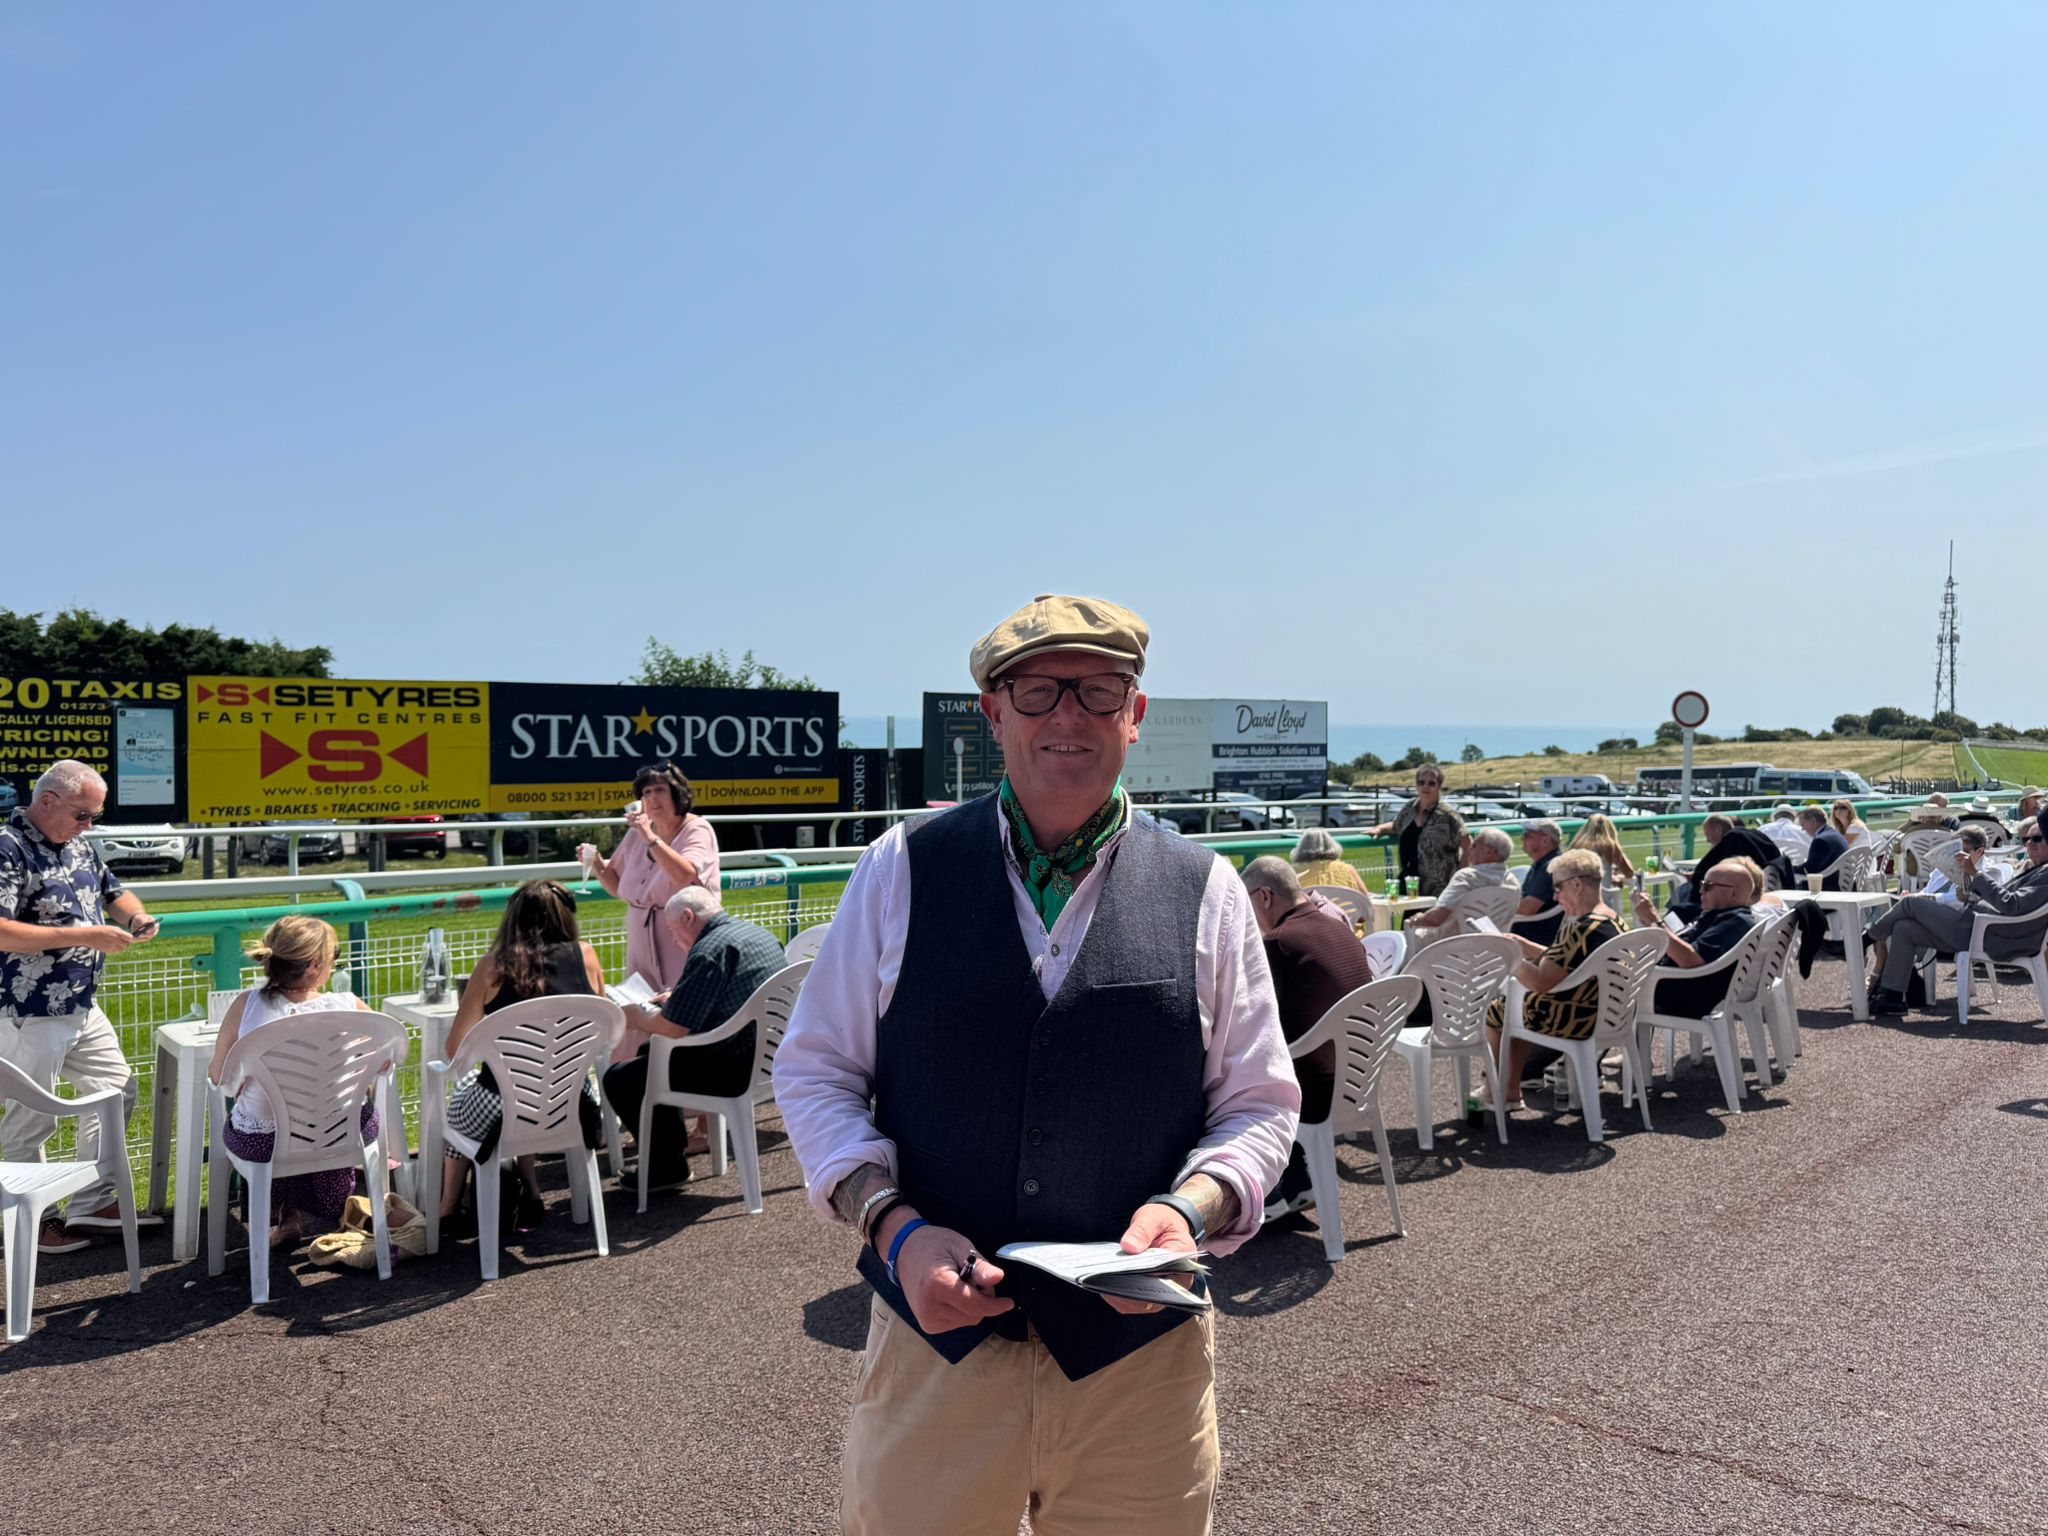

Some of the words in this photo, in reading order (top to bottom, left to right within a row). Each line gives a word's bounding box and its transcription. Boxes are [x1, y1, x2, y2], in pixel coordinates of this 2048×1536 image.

[52, 680, 182, 699] TAXIS
[275, 685, 481, 707] SETYRES
[60, 702, 107, 710] 01273
[938, 700, 967, 713] STAR
[45, 715, 112, 725] LICENSED
[198, 712, 272, 723] FAST
[295, 712, 336, 723] FIT
[357, 713, 481, 724] CENTRES
[1236, 704, 1276, 734] David
[1277, 704, 1307, 734] Lloyd
[0, 729, 109, 742] RICING!
[510, 713, 643, 759] STAR
[656, 715, 823, 757] SPORTS
[1218, 746, 1249, 758] Brighton
[1250, 746, 1277, 756] Rubbish
[1278, 746, 1307, 755] Solutions
[1309, 745, 1320, 755] Ltd
[262, 780, 430, 798] www.setyres.co.uk
[853, 755, 866, 806] SPORTS
[507, 792, 547, 803] 08000
[551, 791, 572, 802] 521
[575, 791, 595, 801] 321
[711, 786, 776, 798] DOWNLOAD
[780, 786, 800, 796] THE
[804, 786, 825, 796] APP
[209, 806, 251, 817] TYRES
[264, 804, 318, 816] BRAKES
[331, 801, 401, 814] TRACKING
[413, 799, 481, 811] SERVICING
